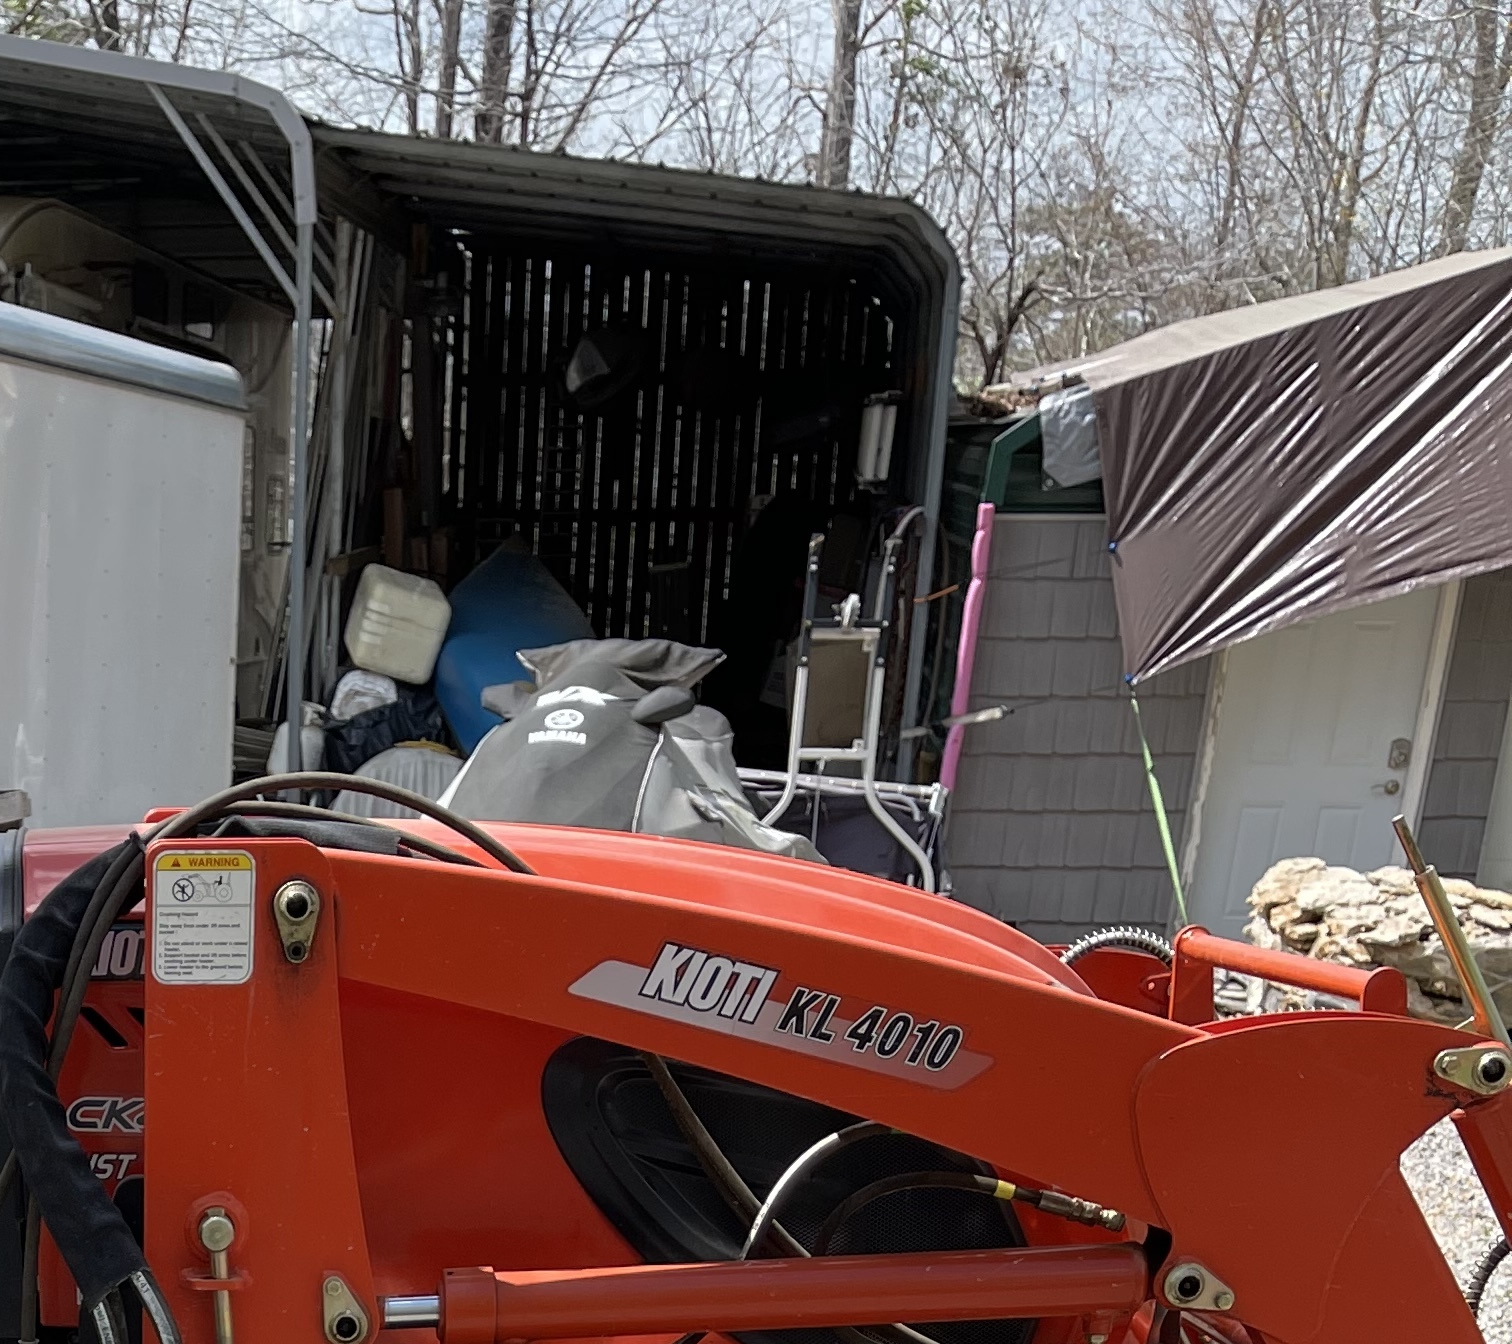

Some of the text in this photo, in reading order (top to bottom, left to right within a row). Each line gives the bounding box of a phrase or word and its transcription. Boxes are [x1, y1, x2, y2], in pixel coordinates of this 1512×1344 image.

[188, 857, 240, 868] WARNING
[637, 940, 965, 1072] KIOTI KL 4010
[66, 1096, 146, 1134] CK
